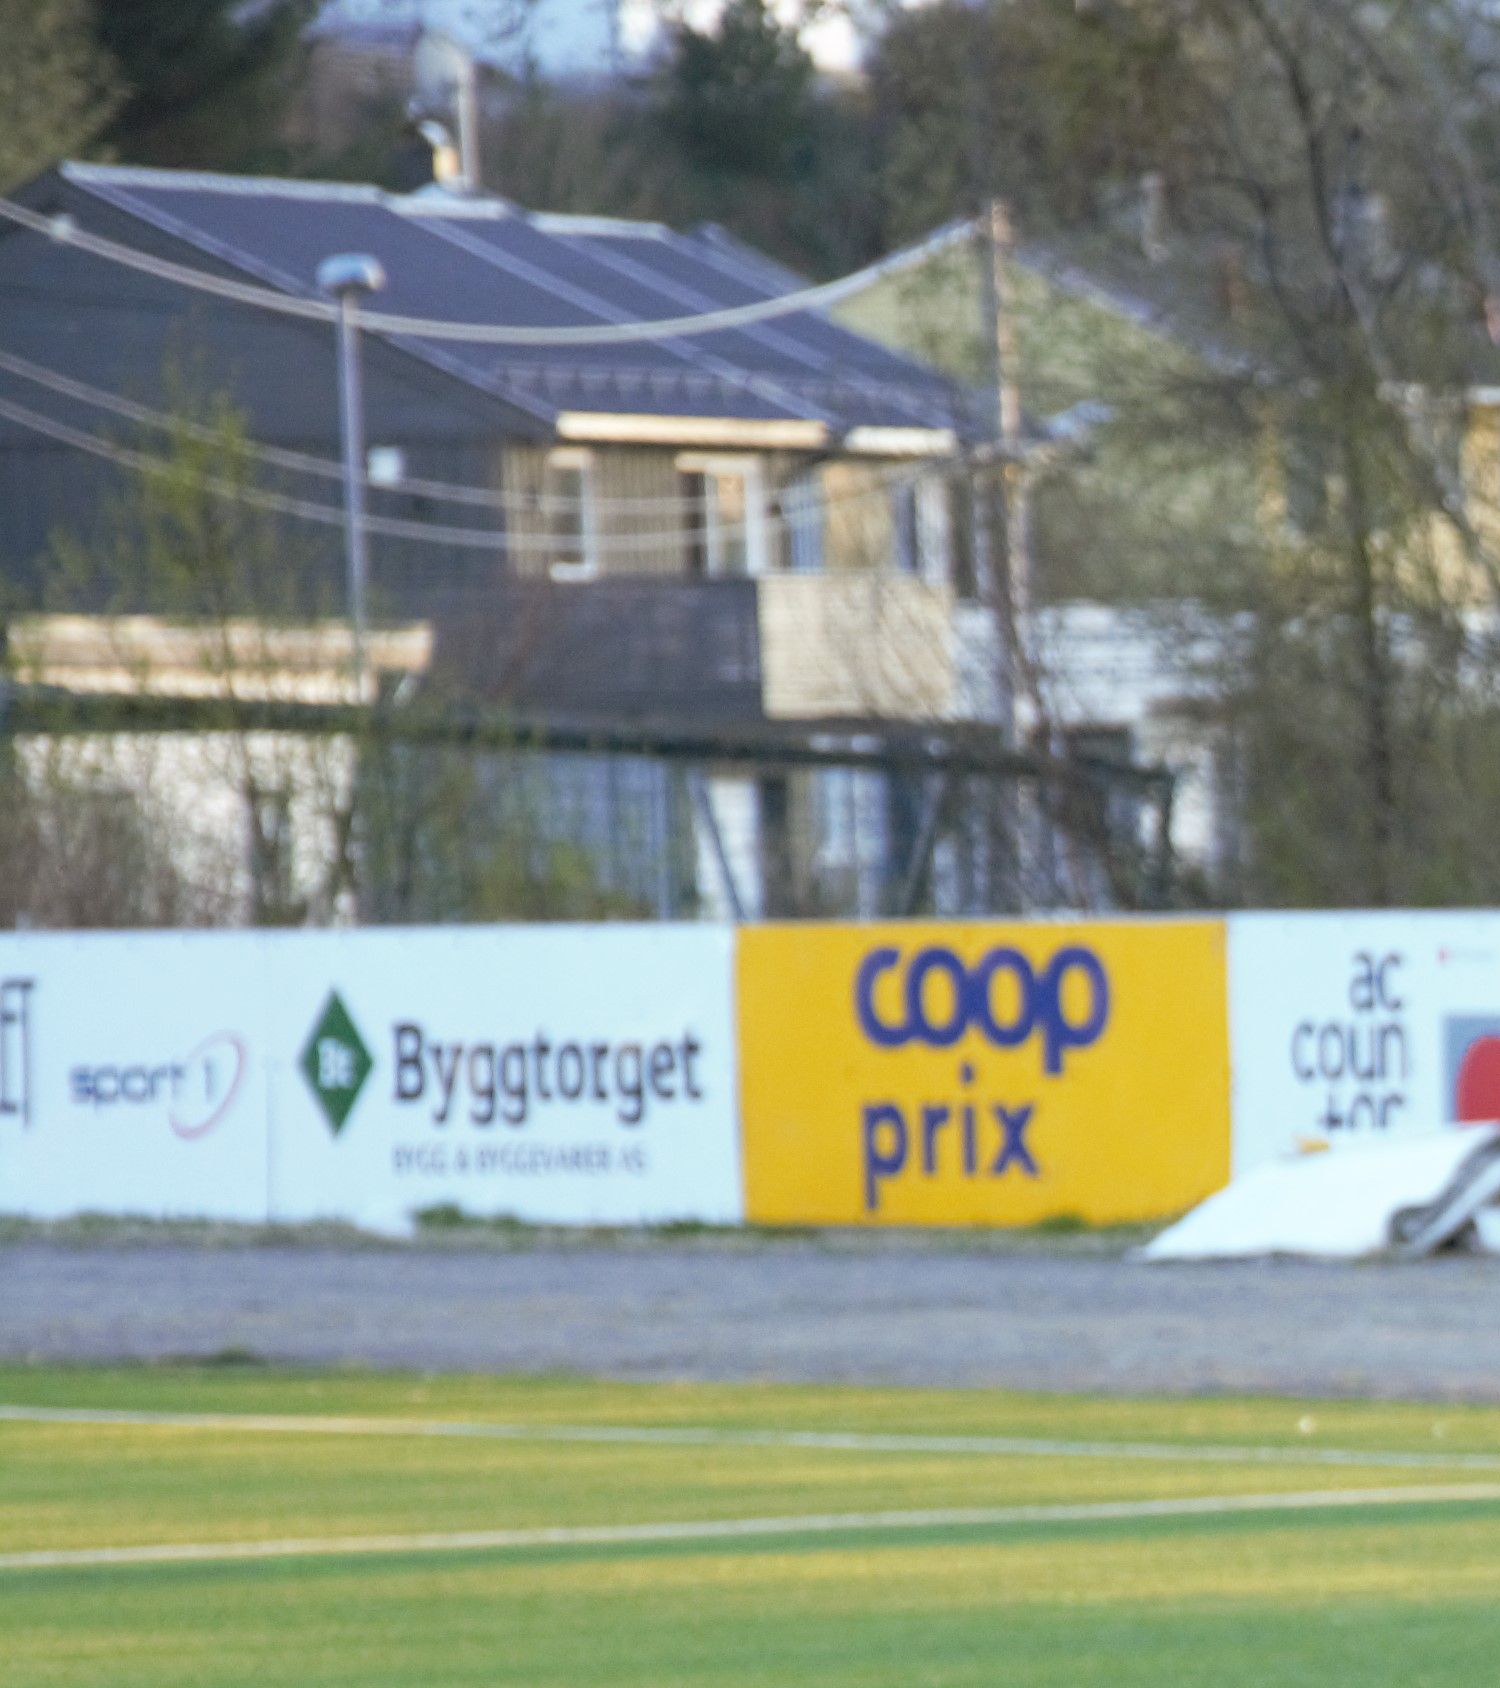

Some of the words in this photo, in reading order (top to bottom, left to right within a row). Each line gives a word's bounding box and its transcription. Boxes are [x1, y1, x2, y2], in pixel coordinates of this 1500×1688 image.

[856, 944, 1111, 1077] coop
[1348, 950, 1402, 1013] ac
[394, 1020, 702, 1128] Byggtorget
[1291, 1020, 1408, 1082] coun
[863, 1063, 1041, 1212] prix
